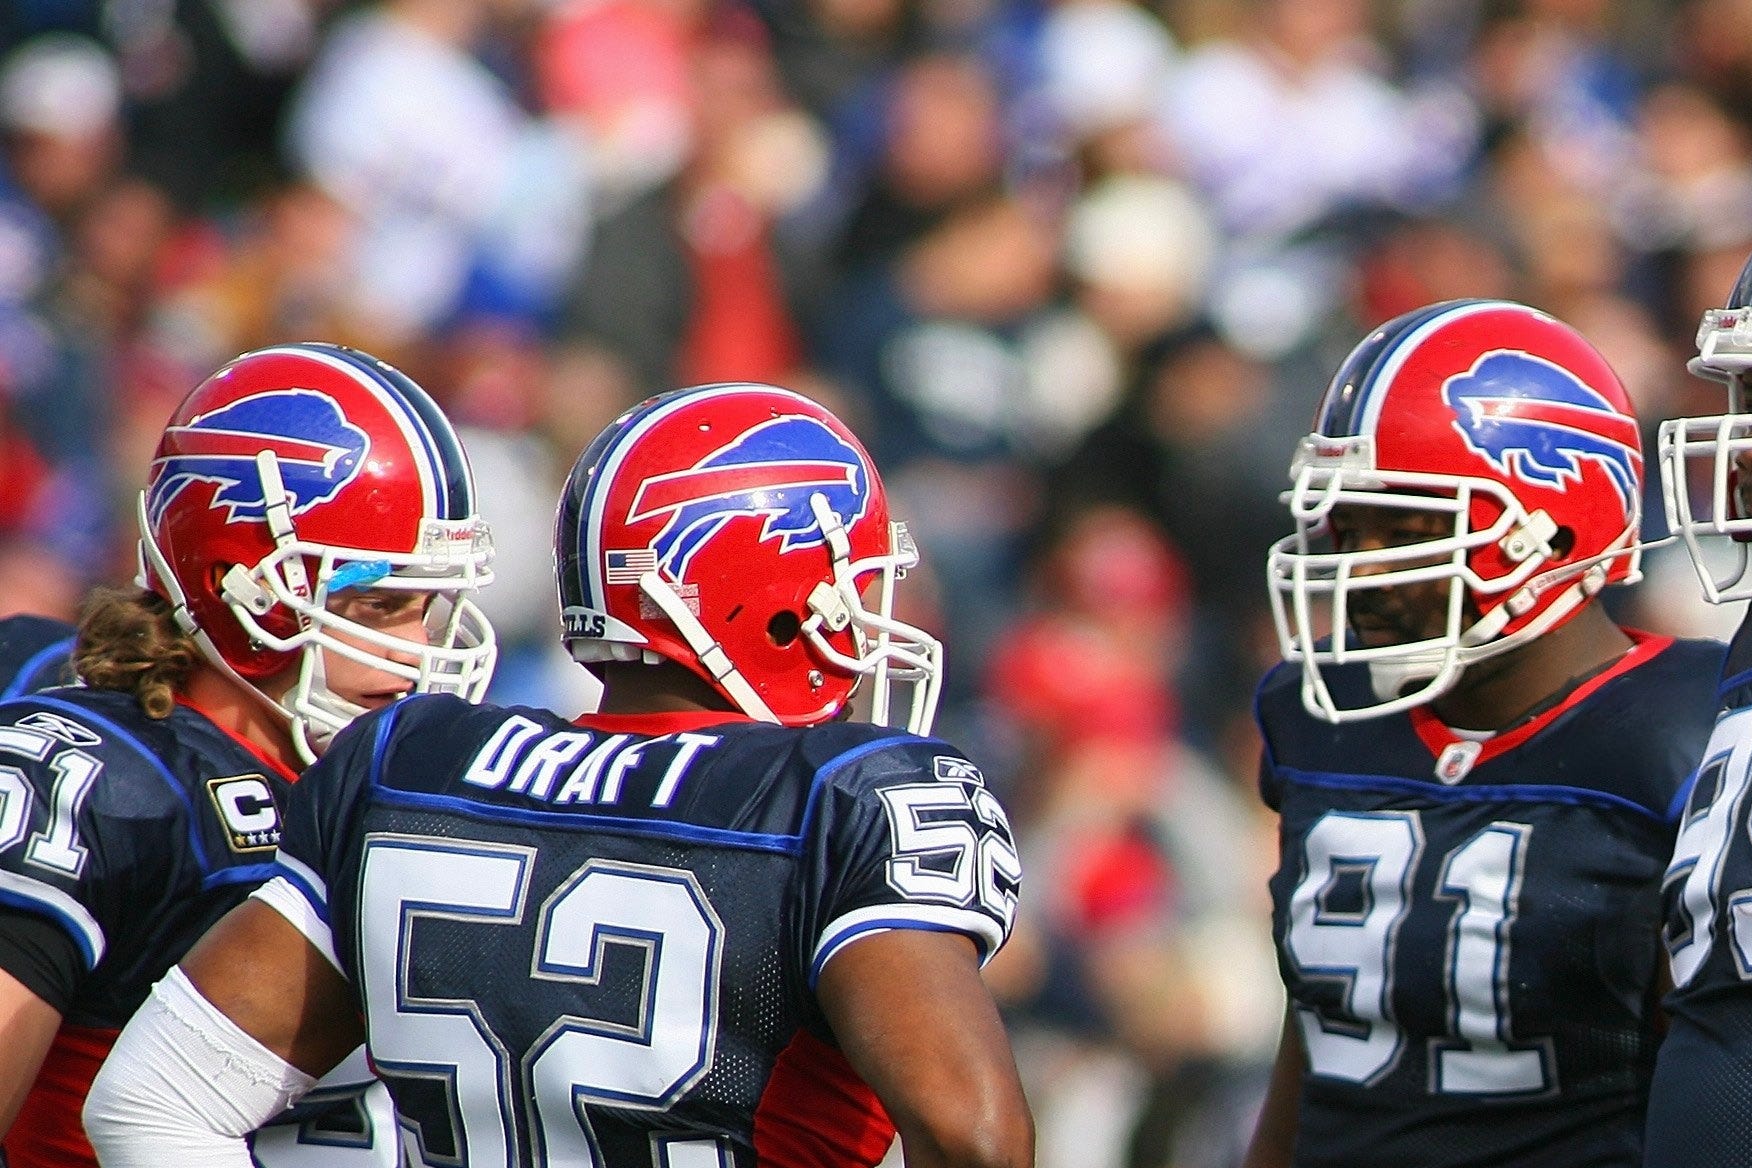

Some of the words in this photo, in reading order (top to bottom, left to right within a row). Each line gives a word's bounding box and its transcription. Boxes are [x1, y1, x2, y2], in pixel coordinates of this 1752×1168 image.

[215, 780, 277, 833] C
[464, 714, 724, 807] DRAFT
[873, 782, 1024, 942] 52
[1285, 808, 1561, 1098] 91
